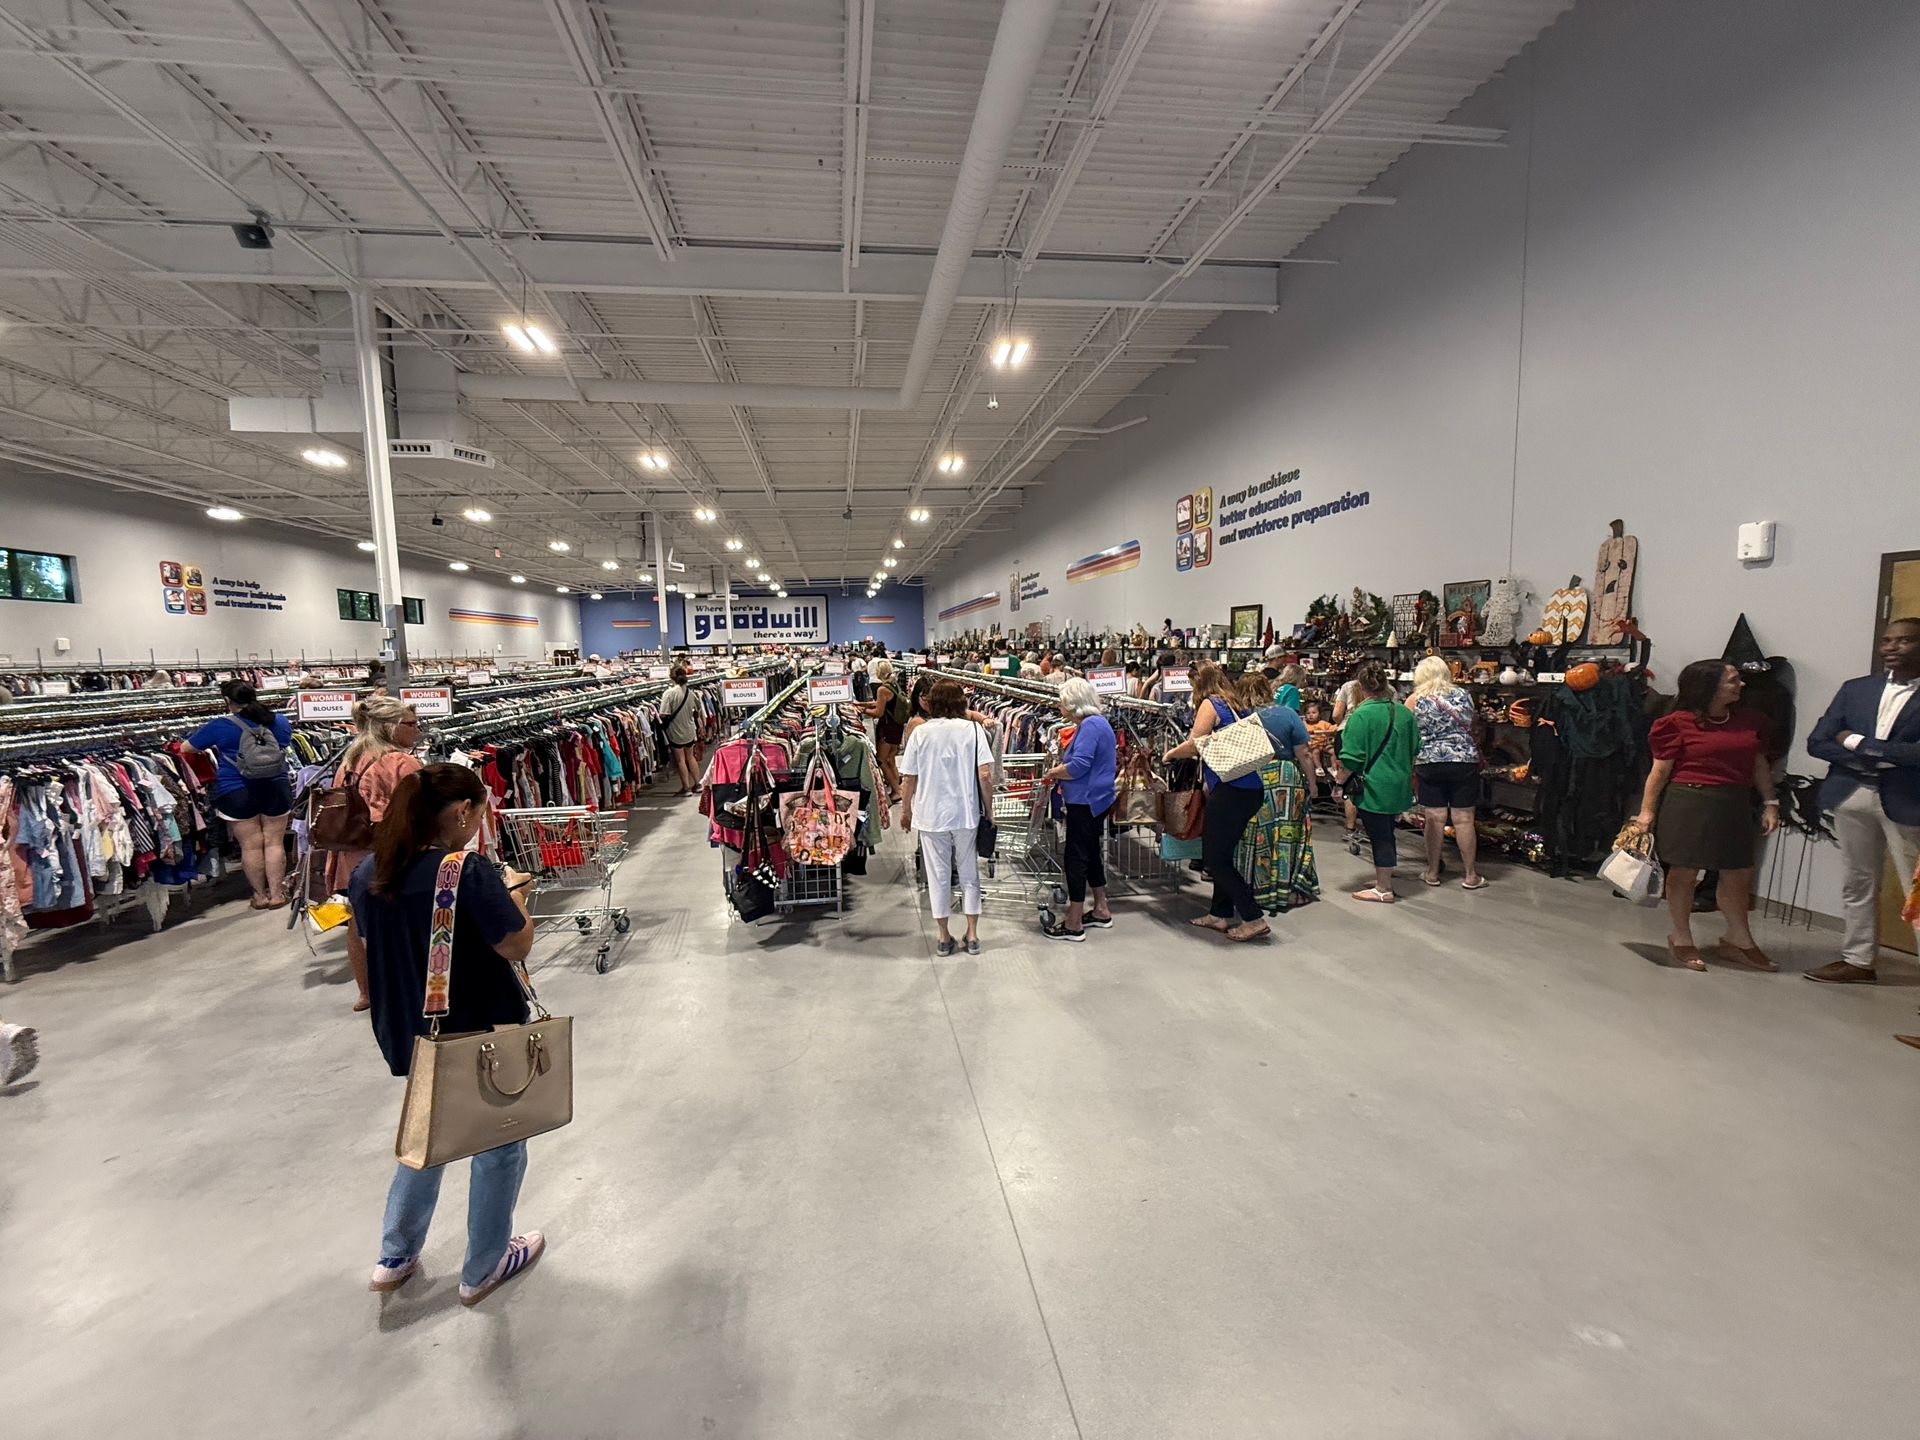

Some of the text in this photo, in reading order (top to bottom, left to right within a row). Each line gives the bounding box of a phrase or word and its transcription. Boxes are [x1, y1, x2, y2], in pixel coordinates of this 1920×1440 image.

[1220, 468, 1300, 508] A way to achieve
[1220, 490, 1302, 527] better education
[1220, 491, 1370, 546] and workforce preparation
[212, 577, 219, 585] A
[694, 607, 818, 640] goodwill
[794, 630, 818, 639] way!
[1094, 671, 1118, 679] WOMEN
